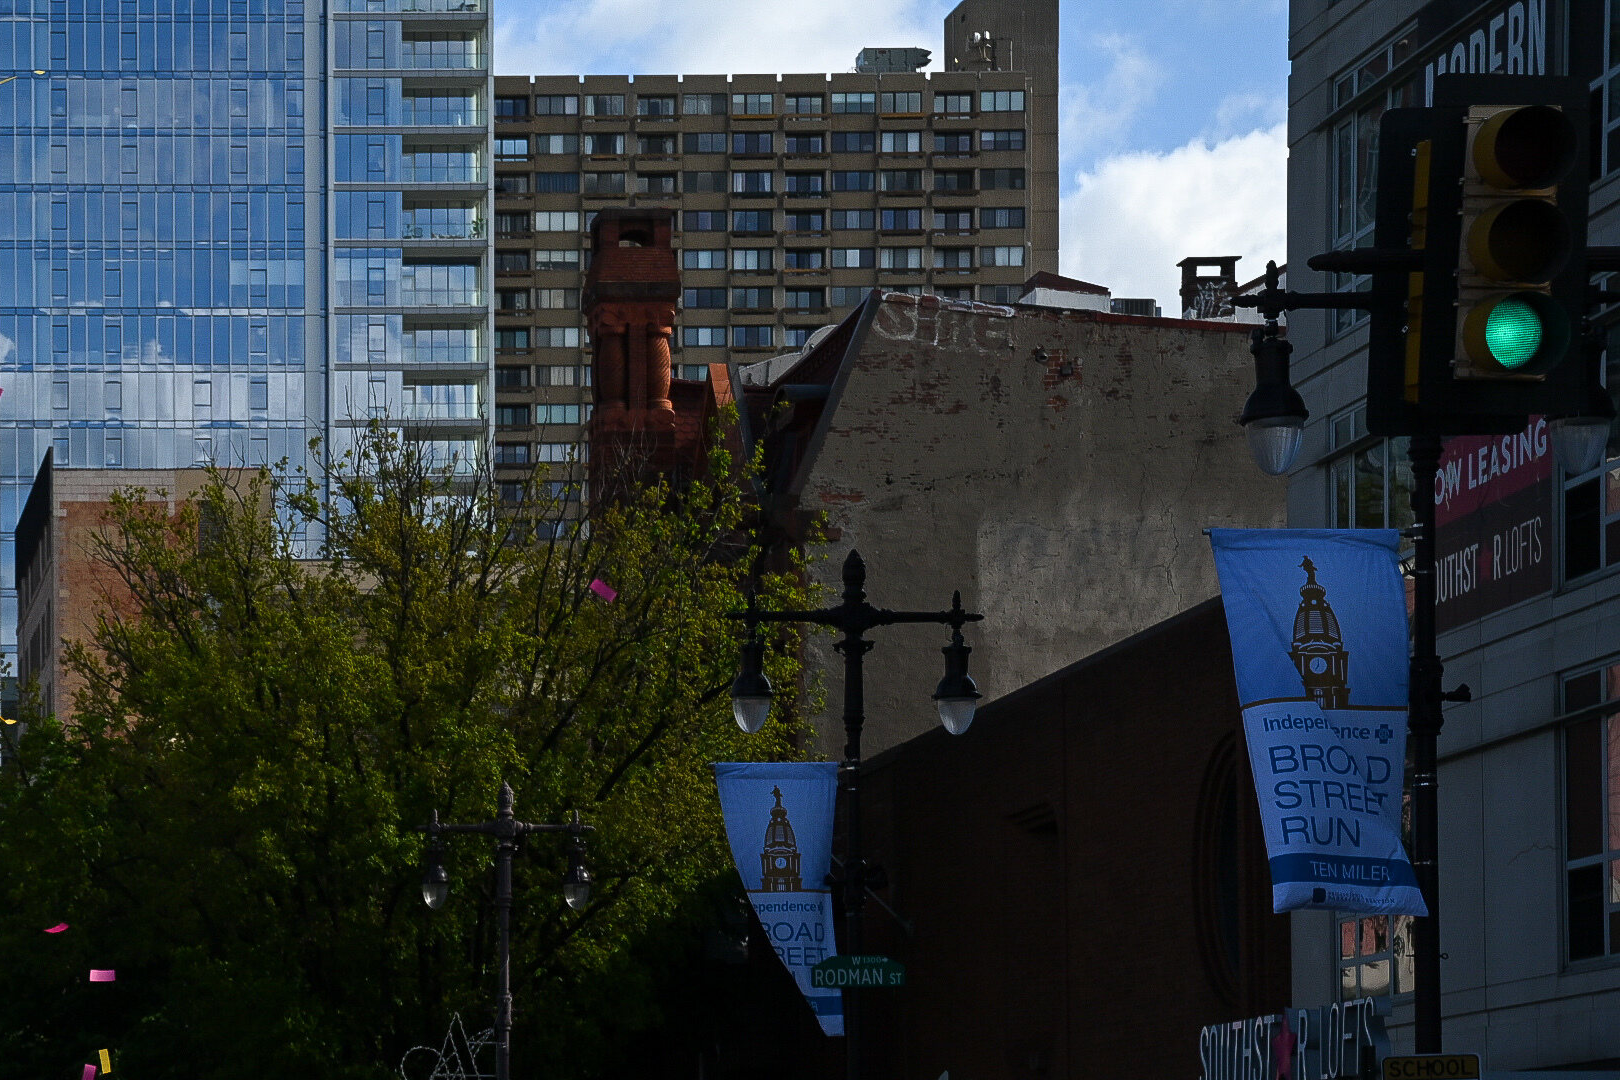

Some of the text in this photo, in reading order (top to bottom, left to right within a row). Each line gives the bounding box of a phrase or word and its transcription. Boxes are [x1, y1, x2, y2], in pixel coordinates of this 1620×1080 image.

[1435, 418, 1547, 506] OW LEASING
[1505, 516, 1542, 576] LOFTS
[1280, 815, 1361, 848] RUN
[1309, 860, 1391, 882] TEN MILER
[814, 968, 903, 986] RODMAN ST
[1388, 1058, 1474, 1078] SCHOOL
